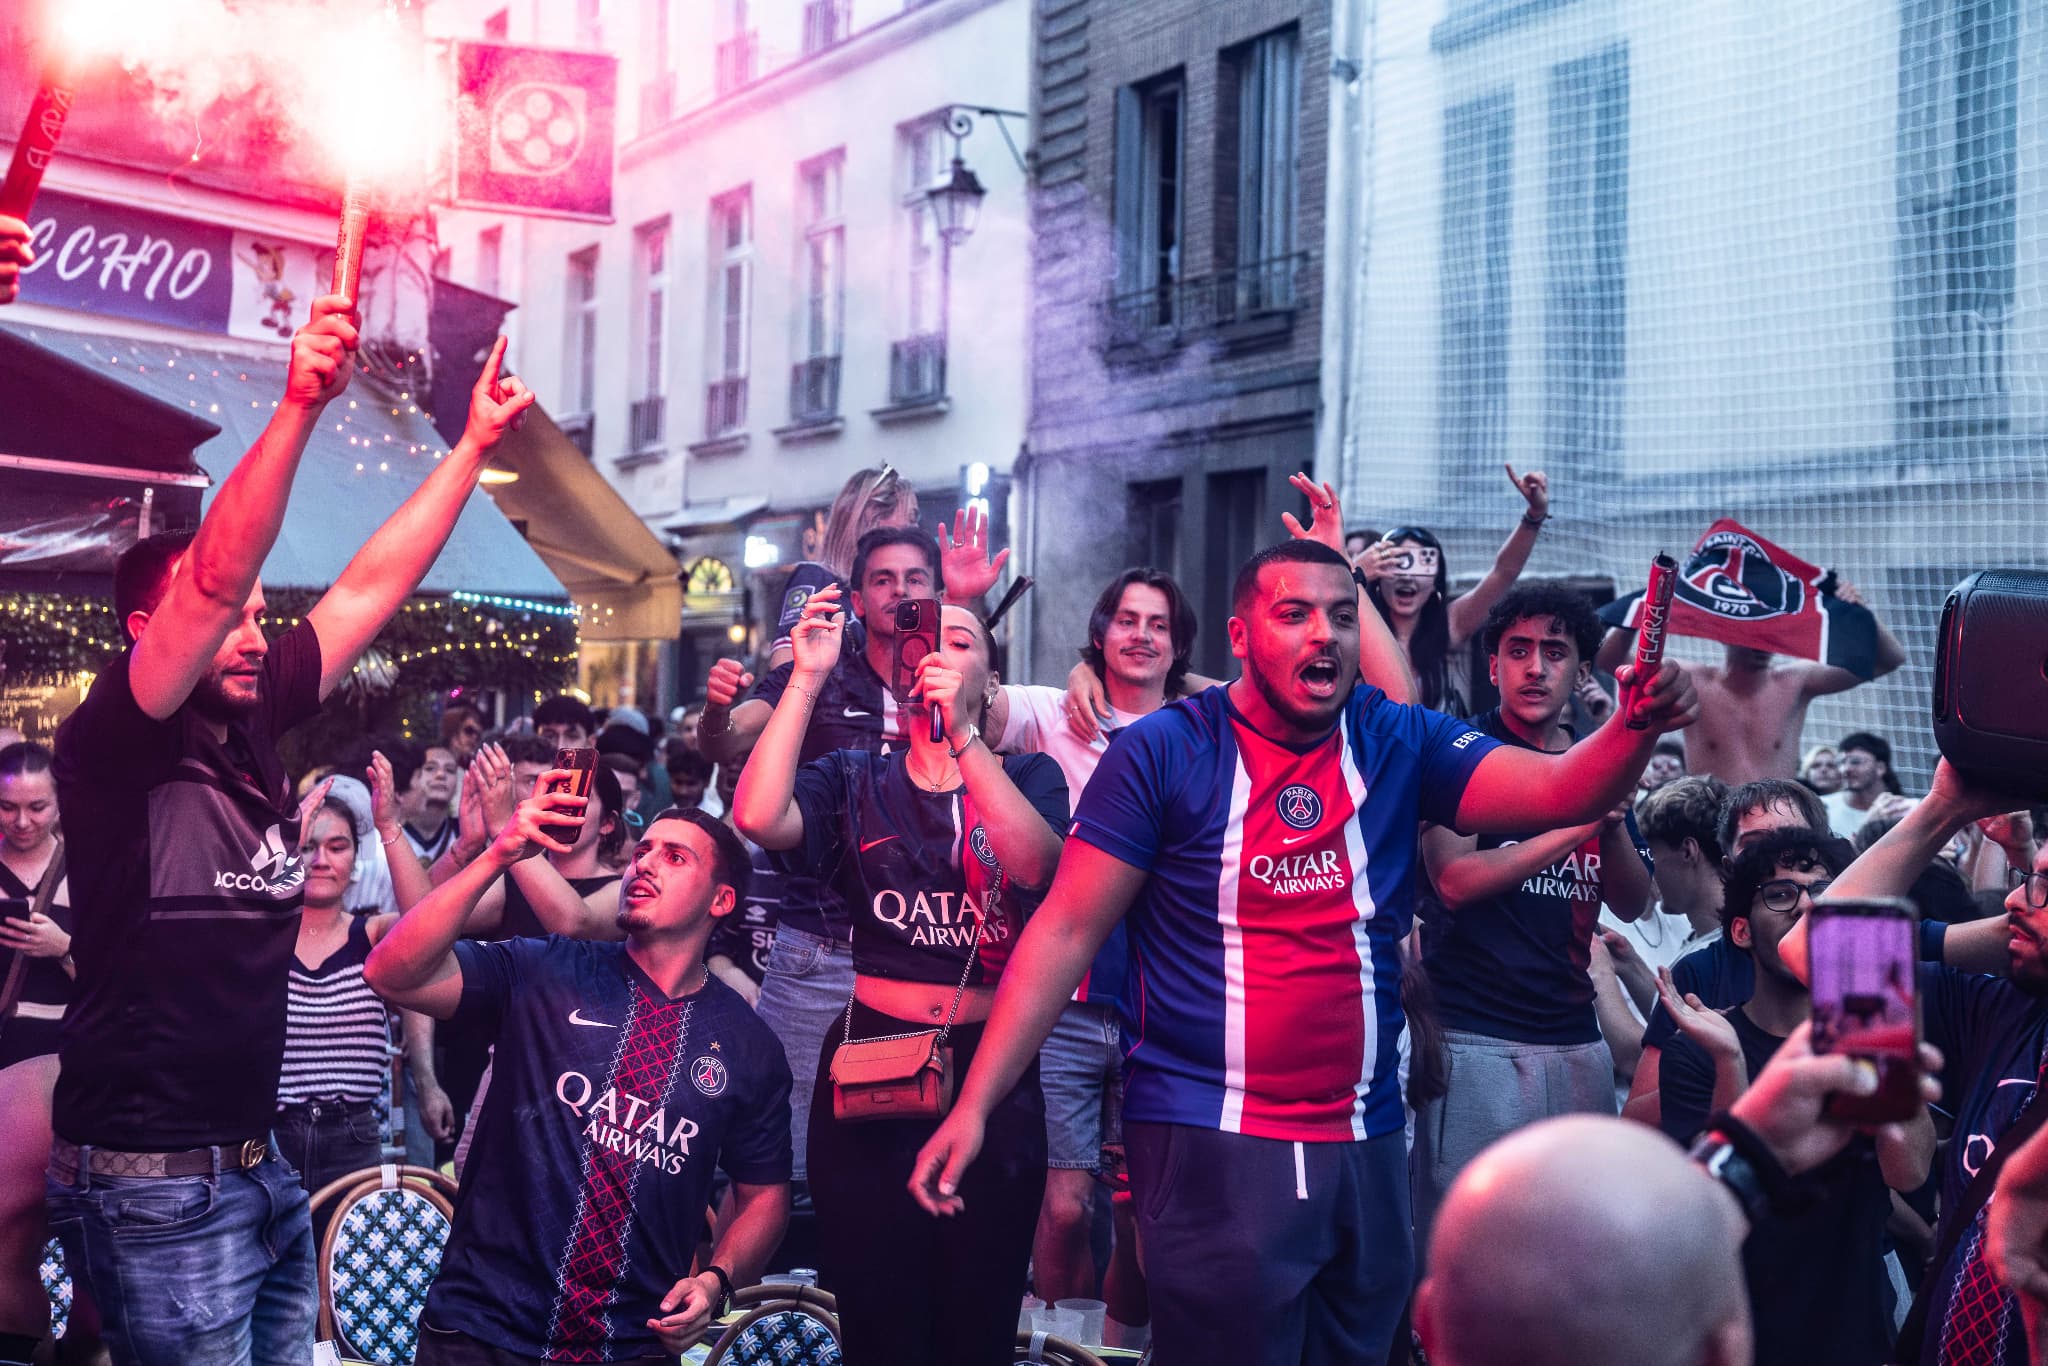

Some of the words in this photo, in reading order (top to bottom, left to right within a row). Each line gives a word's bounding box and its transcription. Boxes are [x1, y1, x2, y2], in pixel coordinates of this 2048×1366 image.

[1713, 599, 1750, 616] 1970
[1639, 604, 1665, 664] FLARA
[1286, 788, 1314, 801] PARIS
[1249, 849, 1343, 885] QATAR
[1273, 873, 1346, 895] AIRWAYS
[1521, 877, 1598, 903] AIRWAYS
[872, 888, 1004, 931] QATAR
[910, 918, 1009, 947] AIRWAYS
[700, 1058, 723, 1073] PARIS
[556, 1071, 700, 1156] QATAR
[582, 1119, 686, 1175] AIRWAYS
